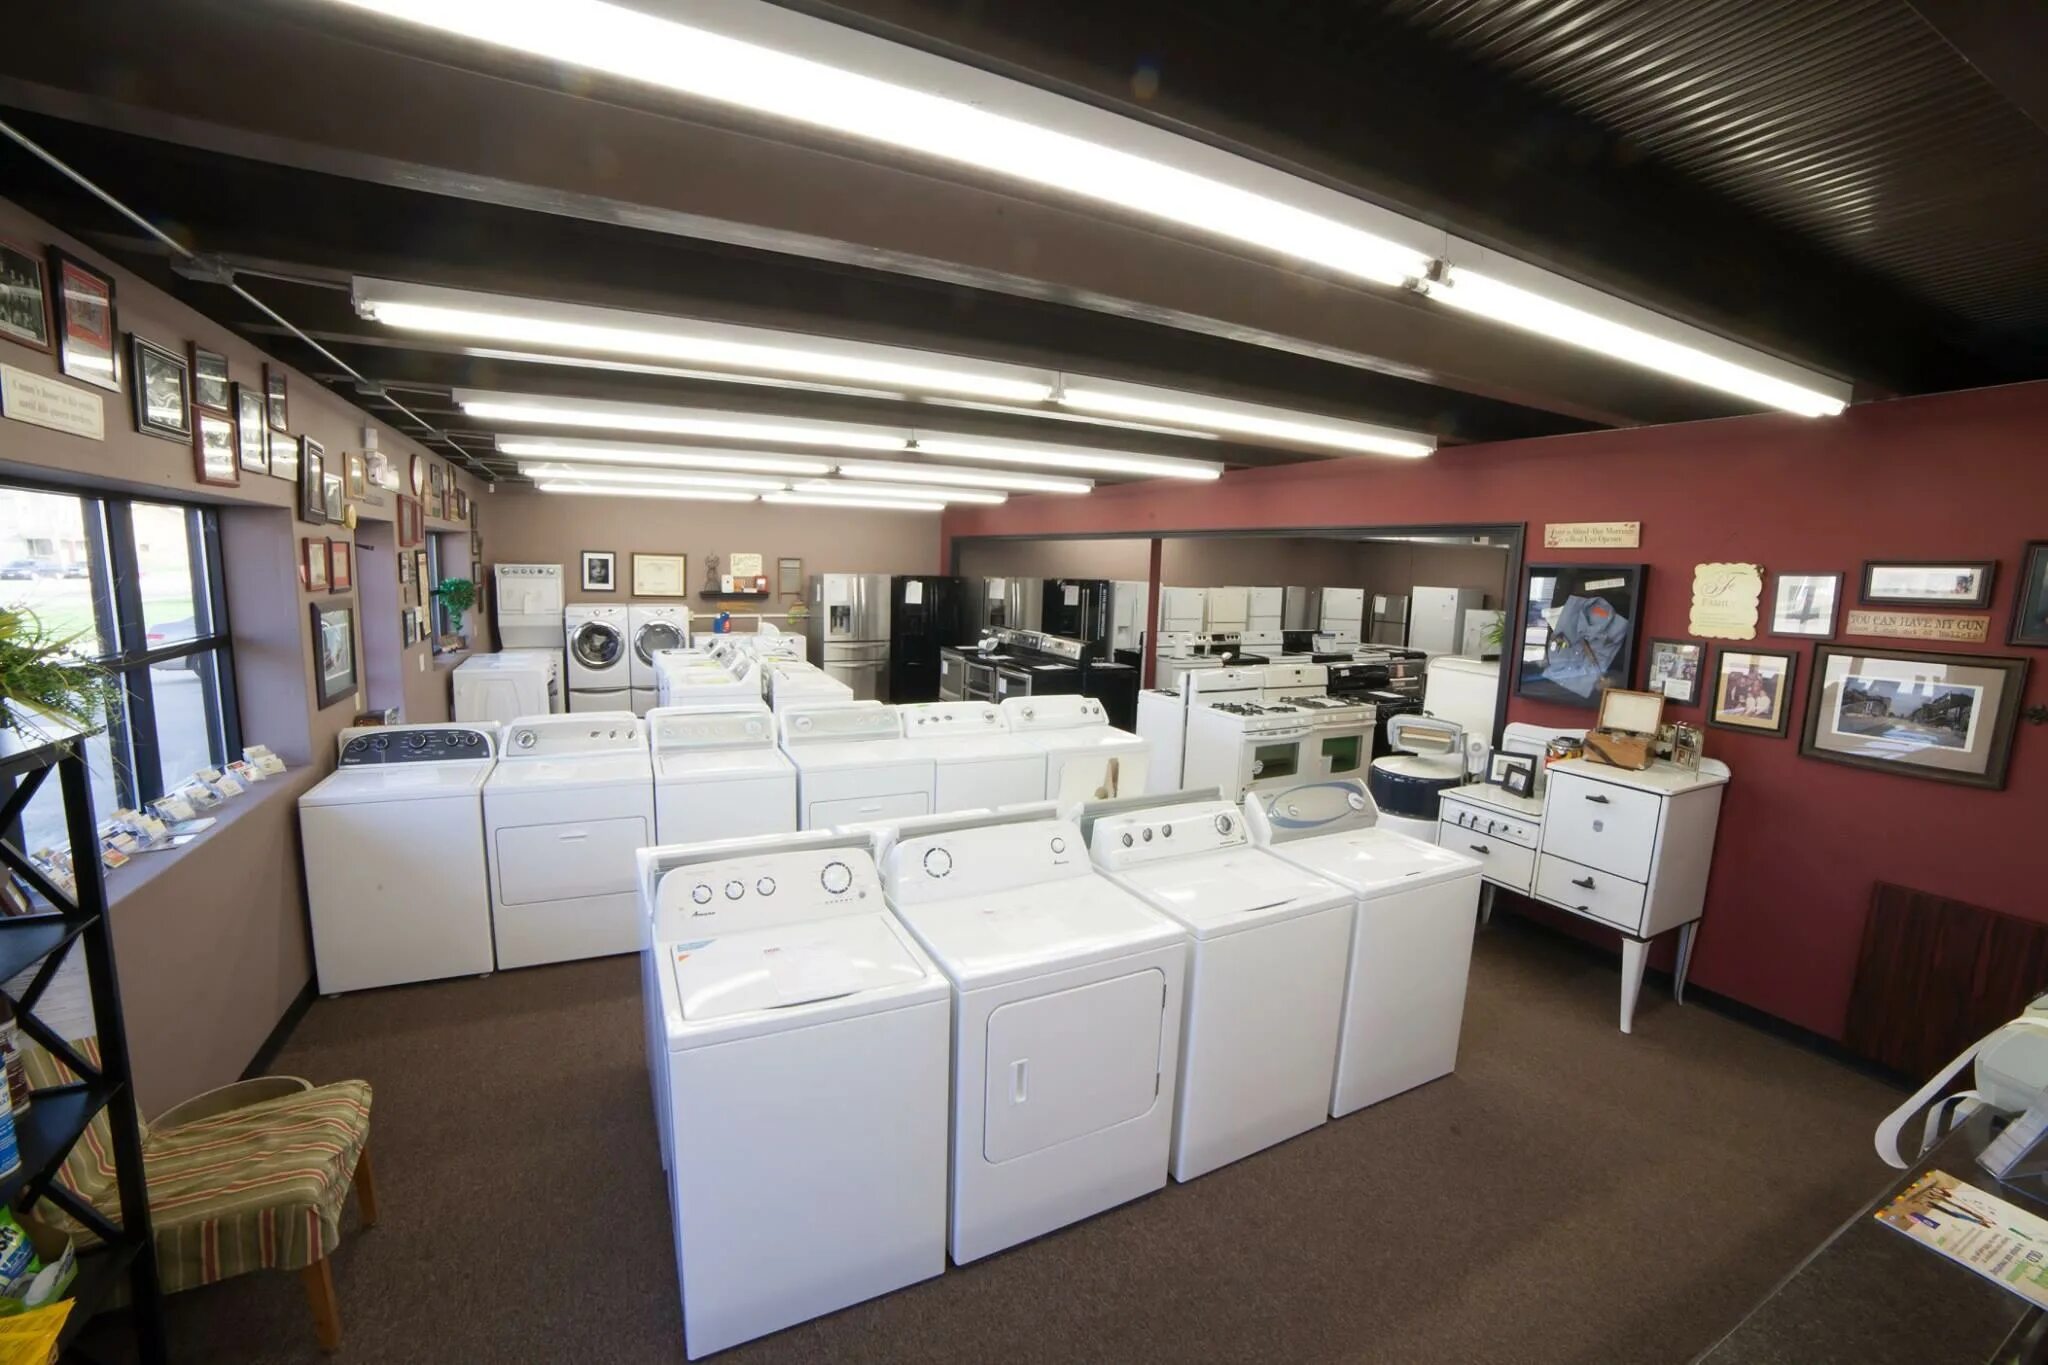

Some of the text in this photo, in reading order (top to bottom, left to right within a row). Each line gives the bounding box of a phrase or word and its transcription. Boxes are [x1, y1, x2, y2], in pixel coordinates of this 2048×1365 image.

[1850, 614, 1985, 631] YOU CAN HAVE MY GUN
